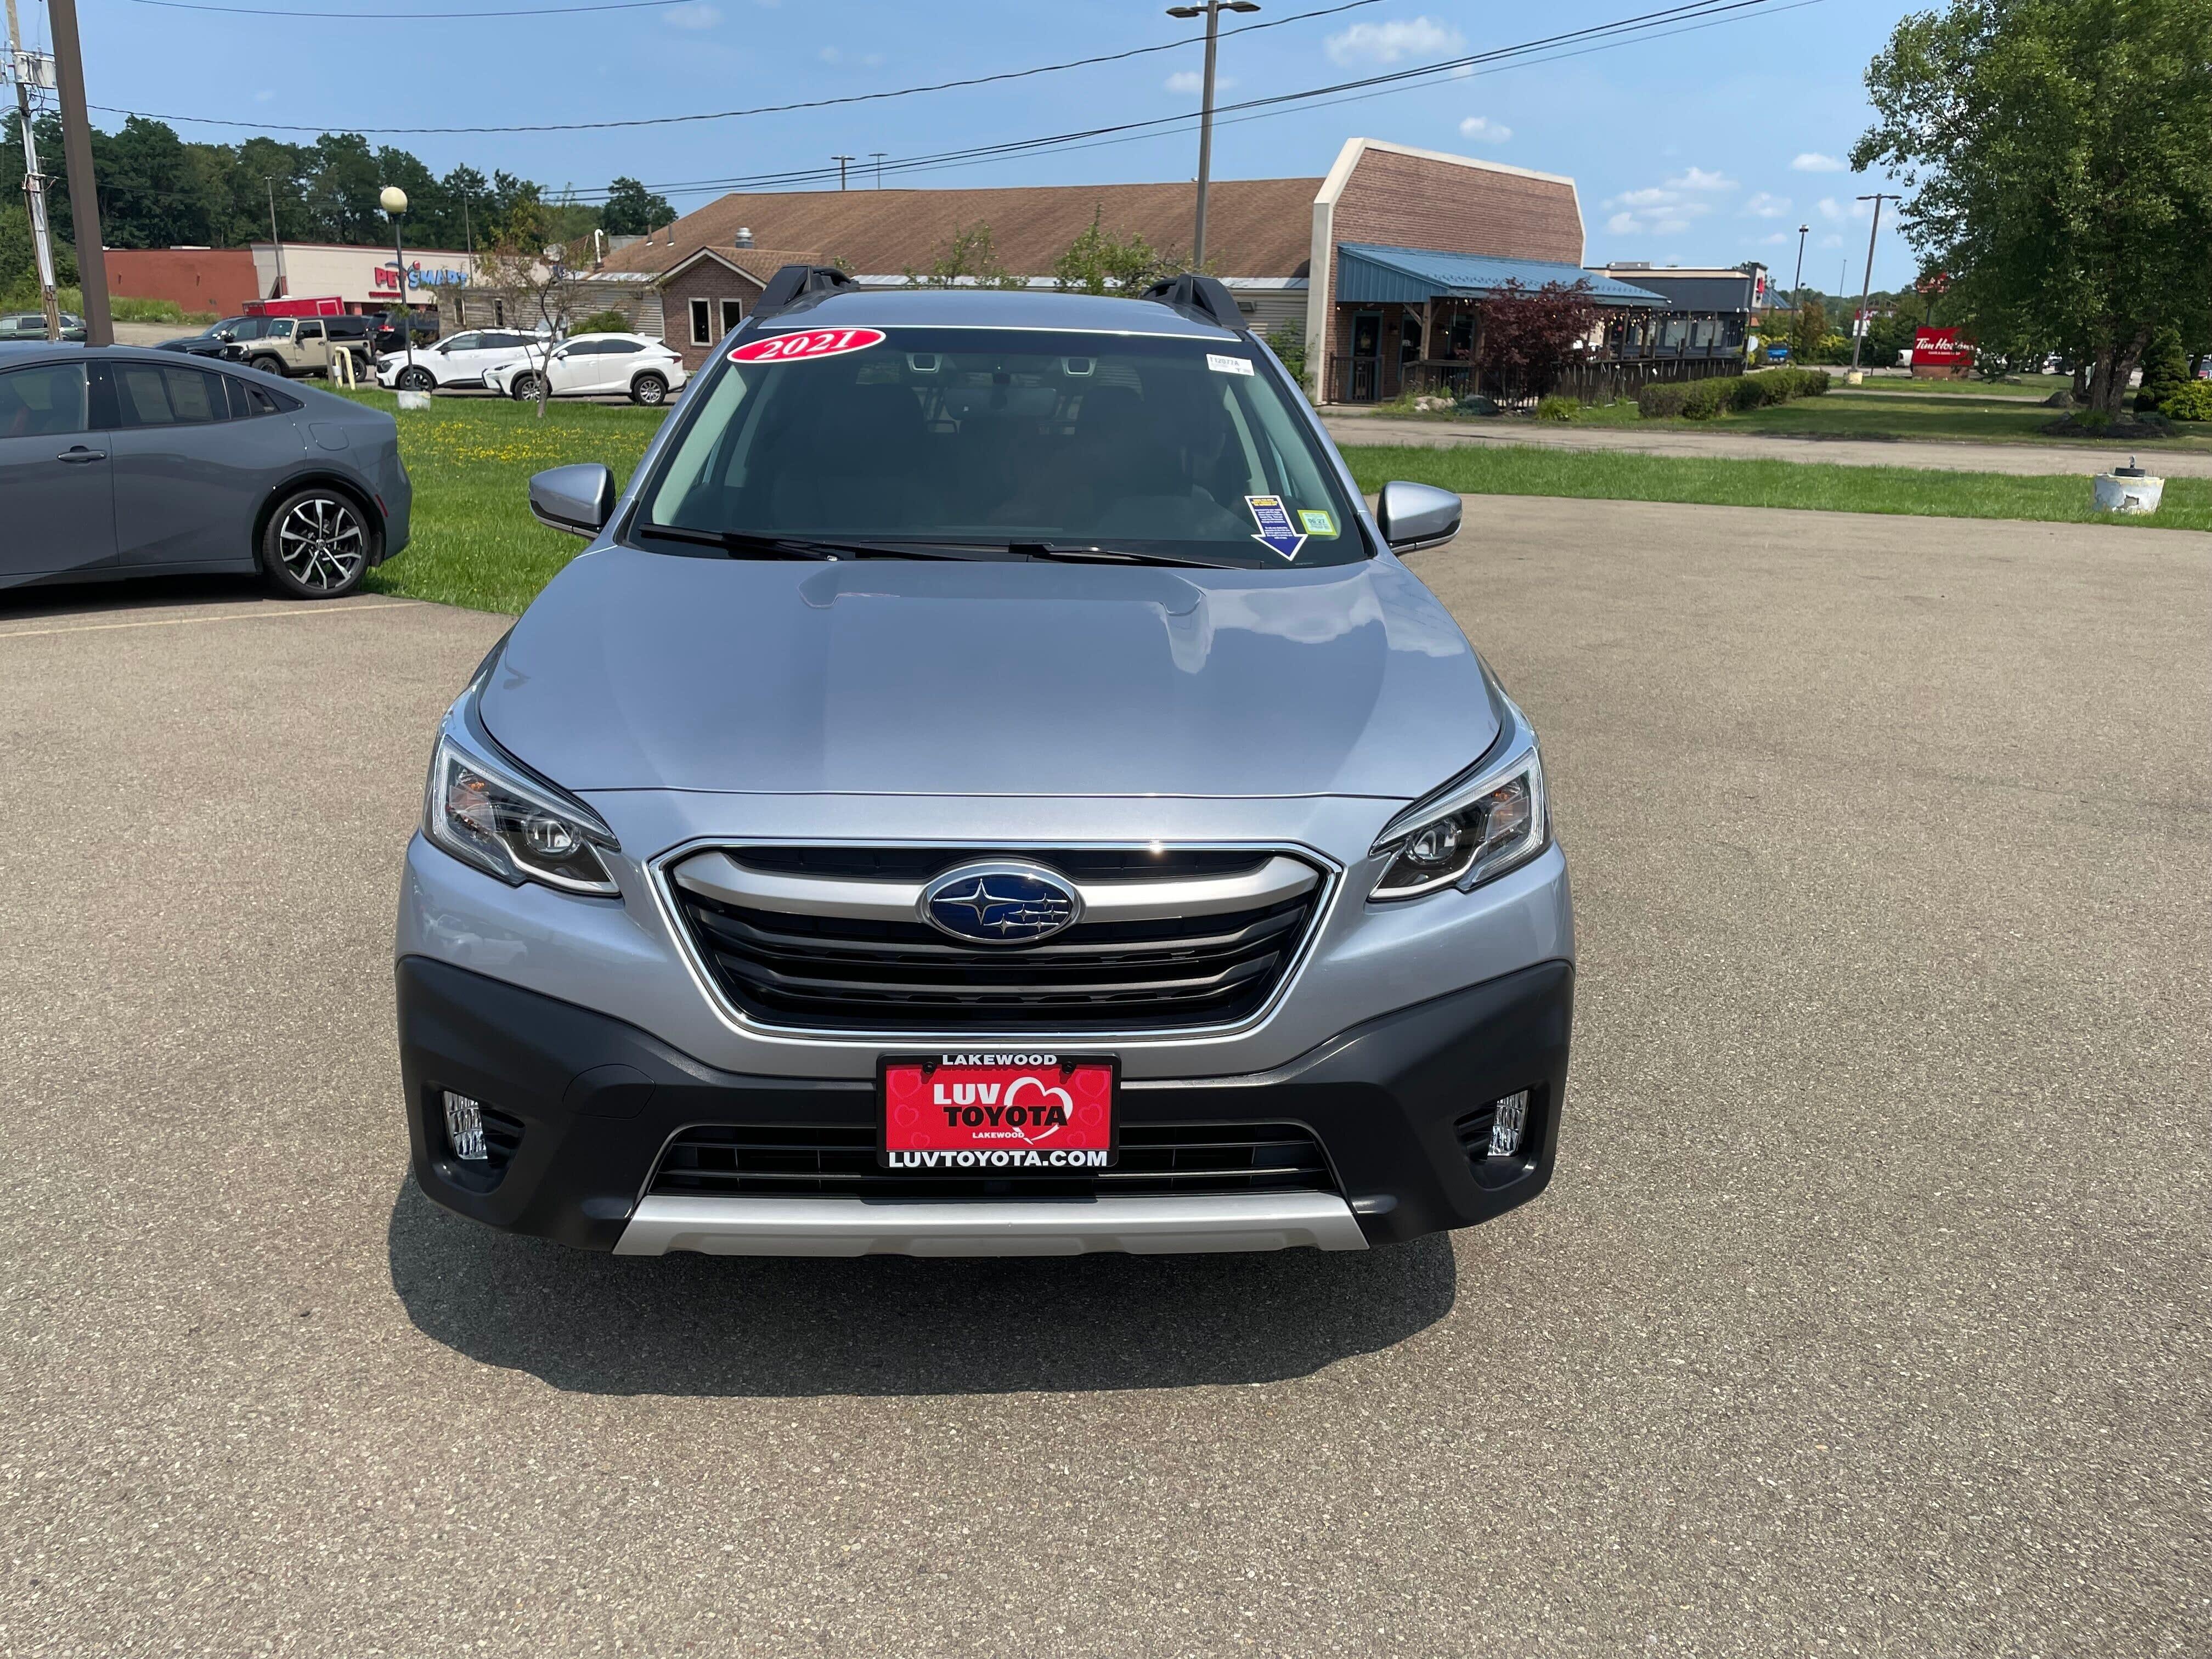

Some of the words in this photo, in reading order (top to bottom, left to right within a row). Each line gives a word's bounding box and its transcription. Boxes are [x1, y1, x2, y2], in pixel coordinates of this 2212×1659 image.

[754, 330, 856, 359] 2021
[1916, 337, 1933, 350] Tim
[942, 1054, 1057, 1065] LAKEWOOD
[934, 1083, 1001, 1105] LUV
[943, 1105, 1068, 1127] TOYOTA
[888, 1150, 1108, 1167] LUVTOYOTA.COM
